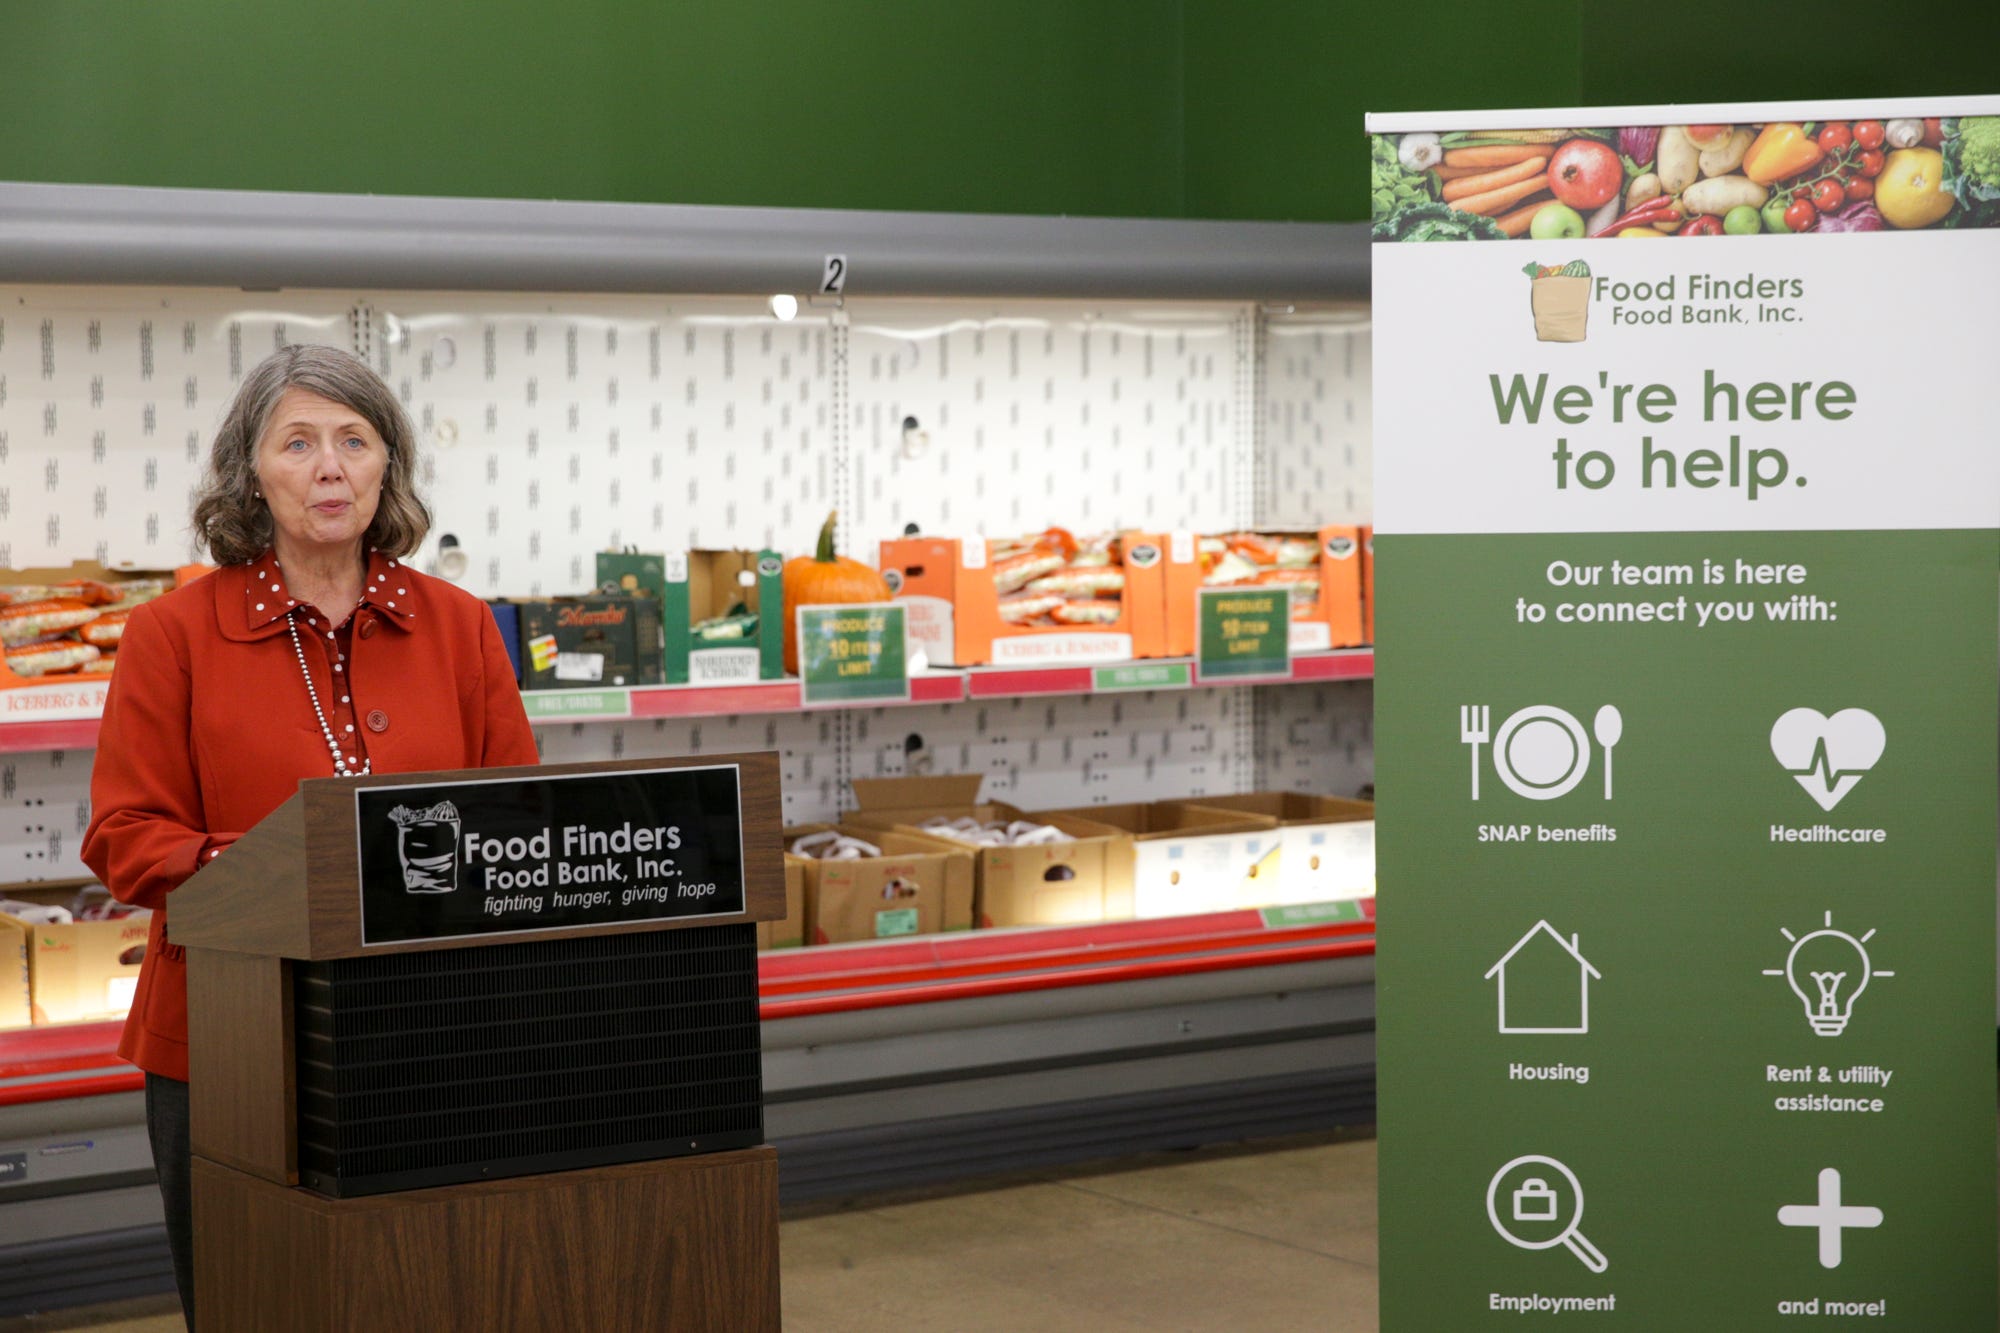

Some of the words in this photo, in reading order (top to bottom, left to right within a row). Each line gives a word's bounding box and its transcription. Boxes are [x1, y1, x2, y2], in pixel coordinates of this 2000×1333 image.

[824, 258, 842, 292] 2
[1595, 274, 1675, 302] Food
[1688, 272, 1804, 300] Finders
[1612, 304, 1672, 326] Food
[1682, 303, 1749, 325] Bank,
[1758, 303, 1803, 323] Inc.
[1488, 370, 1678, 425] We're
[1703, 369, 1857, 422] here
[1552, 437, 1616, 490] to
[1641, 434, 1808, 501] help.
[1546, 560, 1604, 587] Our
[1610, 559, 1694, 586] team
[1703, 558, 1725, 585] is
[1735, 558, 1807, 585] here
[1216, 598, 1274, 614] PRODUCE
[1515, 597, 1547, 623] to
[1555, 595, 1688, 623] connect
[1694, 601, 1754, 628] you
[1763, 594, 1837, 621] with:
[820, 616, 886, 633] PRODUCE
[828, 638, 849, 660] 10
[850, 641, 882, 656] ITEM
[837, 661, 872, 677] LIMIT
[6, 693, 73, 712] ICEBERG
[77, 694, 90, 708] &
[464, 827, 550, 864] Food
[563, 822, 682, 857] Finders
[1477, 824, 1532, 842] SNAP
[1537, 823, 1617, 842] benefits
[1770, 824, 1887, 843] Healthcare
[484, 863, 549, 891] Food
[557, 857, 629, 886] Bank,
[636, 856, 683, 879] Inc.
[483, 893, 543, 917] fighting
[552, 889, 612, 910] hunger,
[621, 884, 668, 905] giving
[677, 881, 716, 900] hope
[1509, 1062, 1590, 1084] Housing
[1766, 1064, 1813, 1083] Rent
[1817, 1066, 1833, 1083] &
[1838, 1065, 1893, 1088] utility
[1774, 1093, 1885, 1113] assistance
[1489, 1293, 1617, 1315] Employment
[1777, 1297, 1819, 1315] and
[1824, 1299, 1886, 1317] more!
